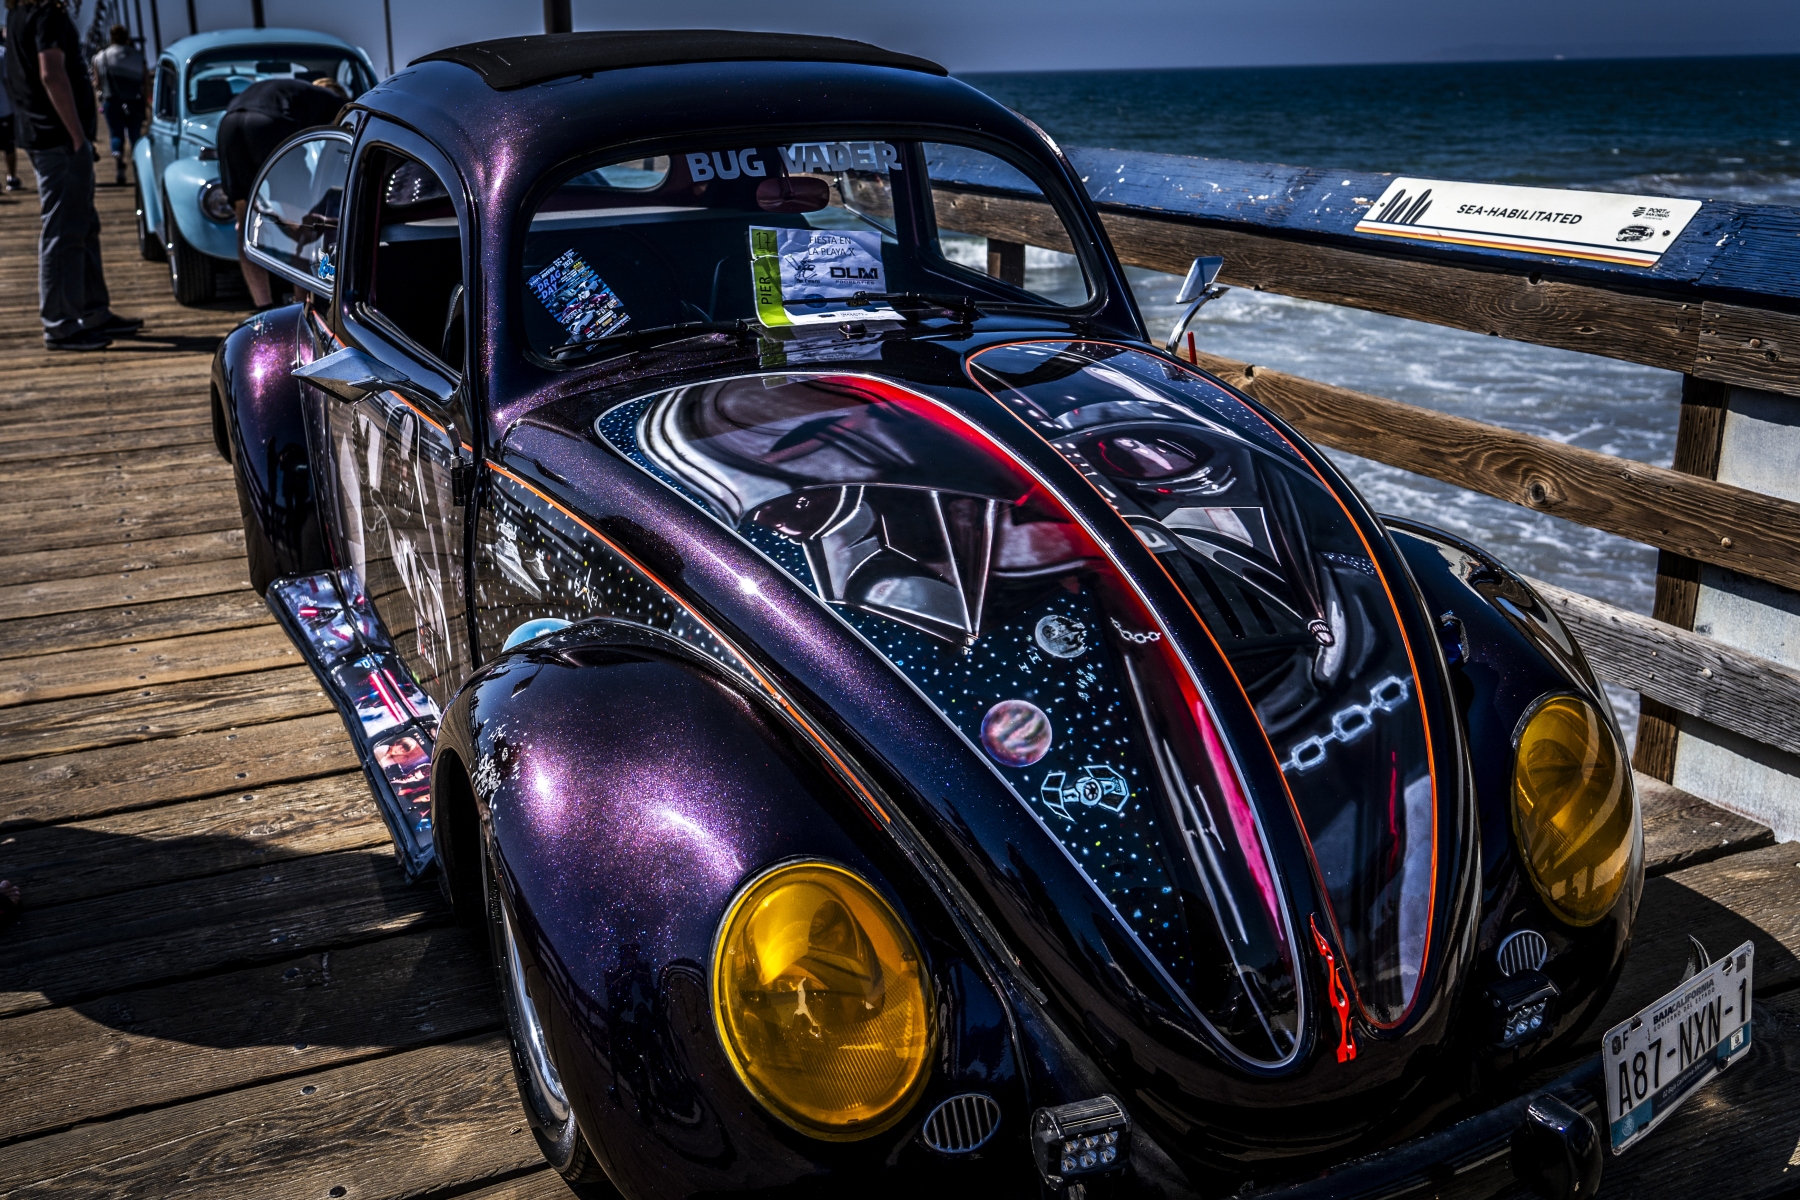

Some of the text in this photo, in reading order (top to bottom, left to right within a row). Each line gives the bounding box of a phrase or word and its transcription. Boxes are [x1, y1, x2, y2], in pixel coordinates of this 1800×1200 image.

[686, 143, 902, 183] BUG VADER
[1456, 203, 1583, 226] SEA-HABILITATED
[808, 247, 818, 256] LA
[821, 247, 845, 256] PLAYA
[809, 236, 852, 245] FIESTA EN
[537, 270, 561, 292] DRAG
[830, 266, 879, 280] DLM
[542, 281, 557, 299] DAY
[759, 275, 773, 305] PIER
[1653, 987, 1715, 1032] GOBIERNO DEL ESTADO
[1618, 976, 1748, 1117] A87-NXN-1
